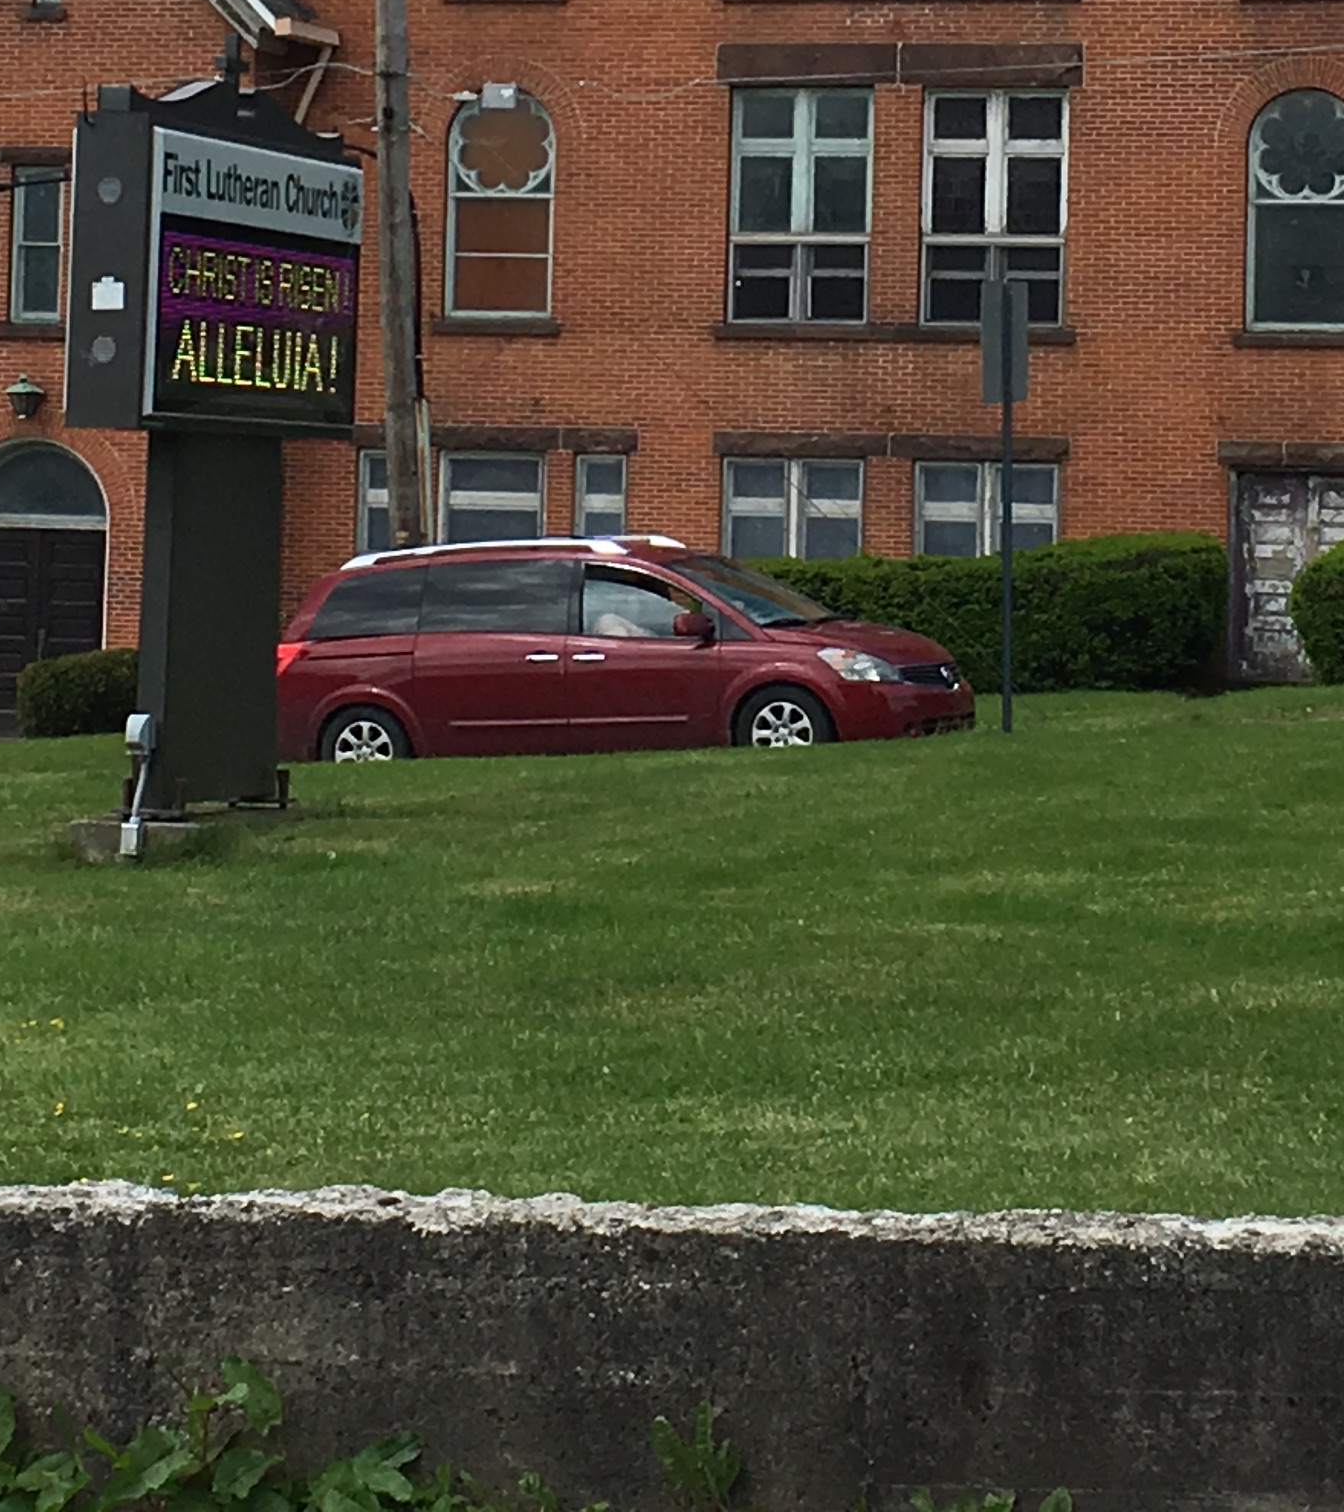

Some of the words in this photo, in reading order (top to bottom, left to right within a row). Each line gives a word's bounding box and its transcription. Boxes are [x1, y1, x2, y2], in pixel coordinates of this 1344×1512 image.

[163, 151, 202, 199] First
[206, 158, 281, 211] Lutheran
[285, 172, 339, 220] Church
[169, 246, 252, 302] CHRIST
[255, 257, 273, 306] IS
[171, 318, 338, 394] ALLELUIA!
